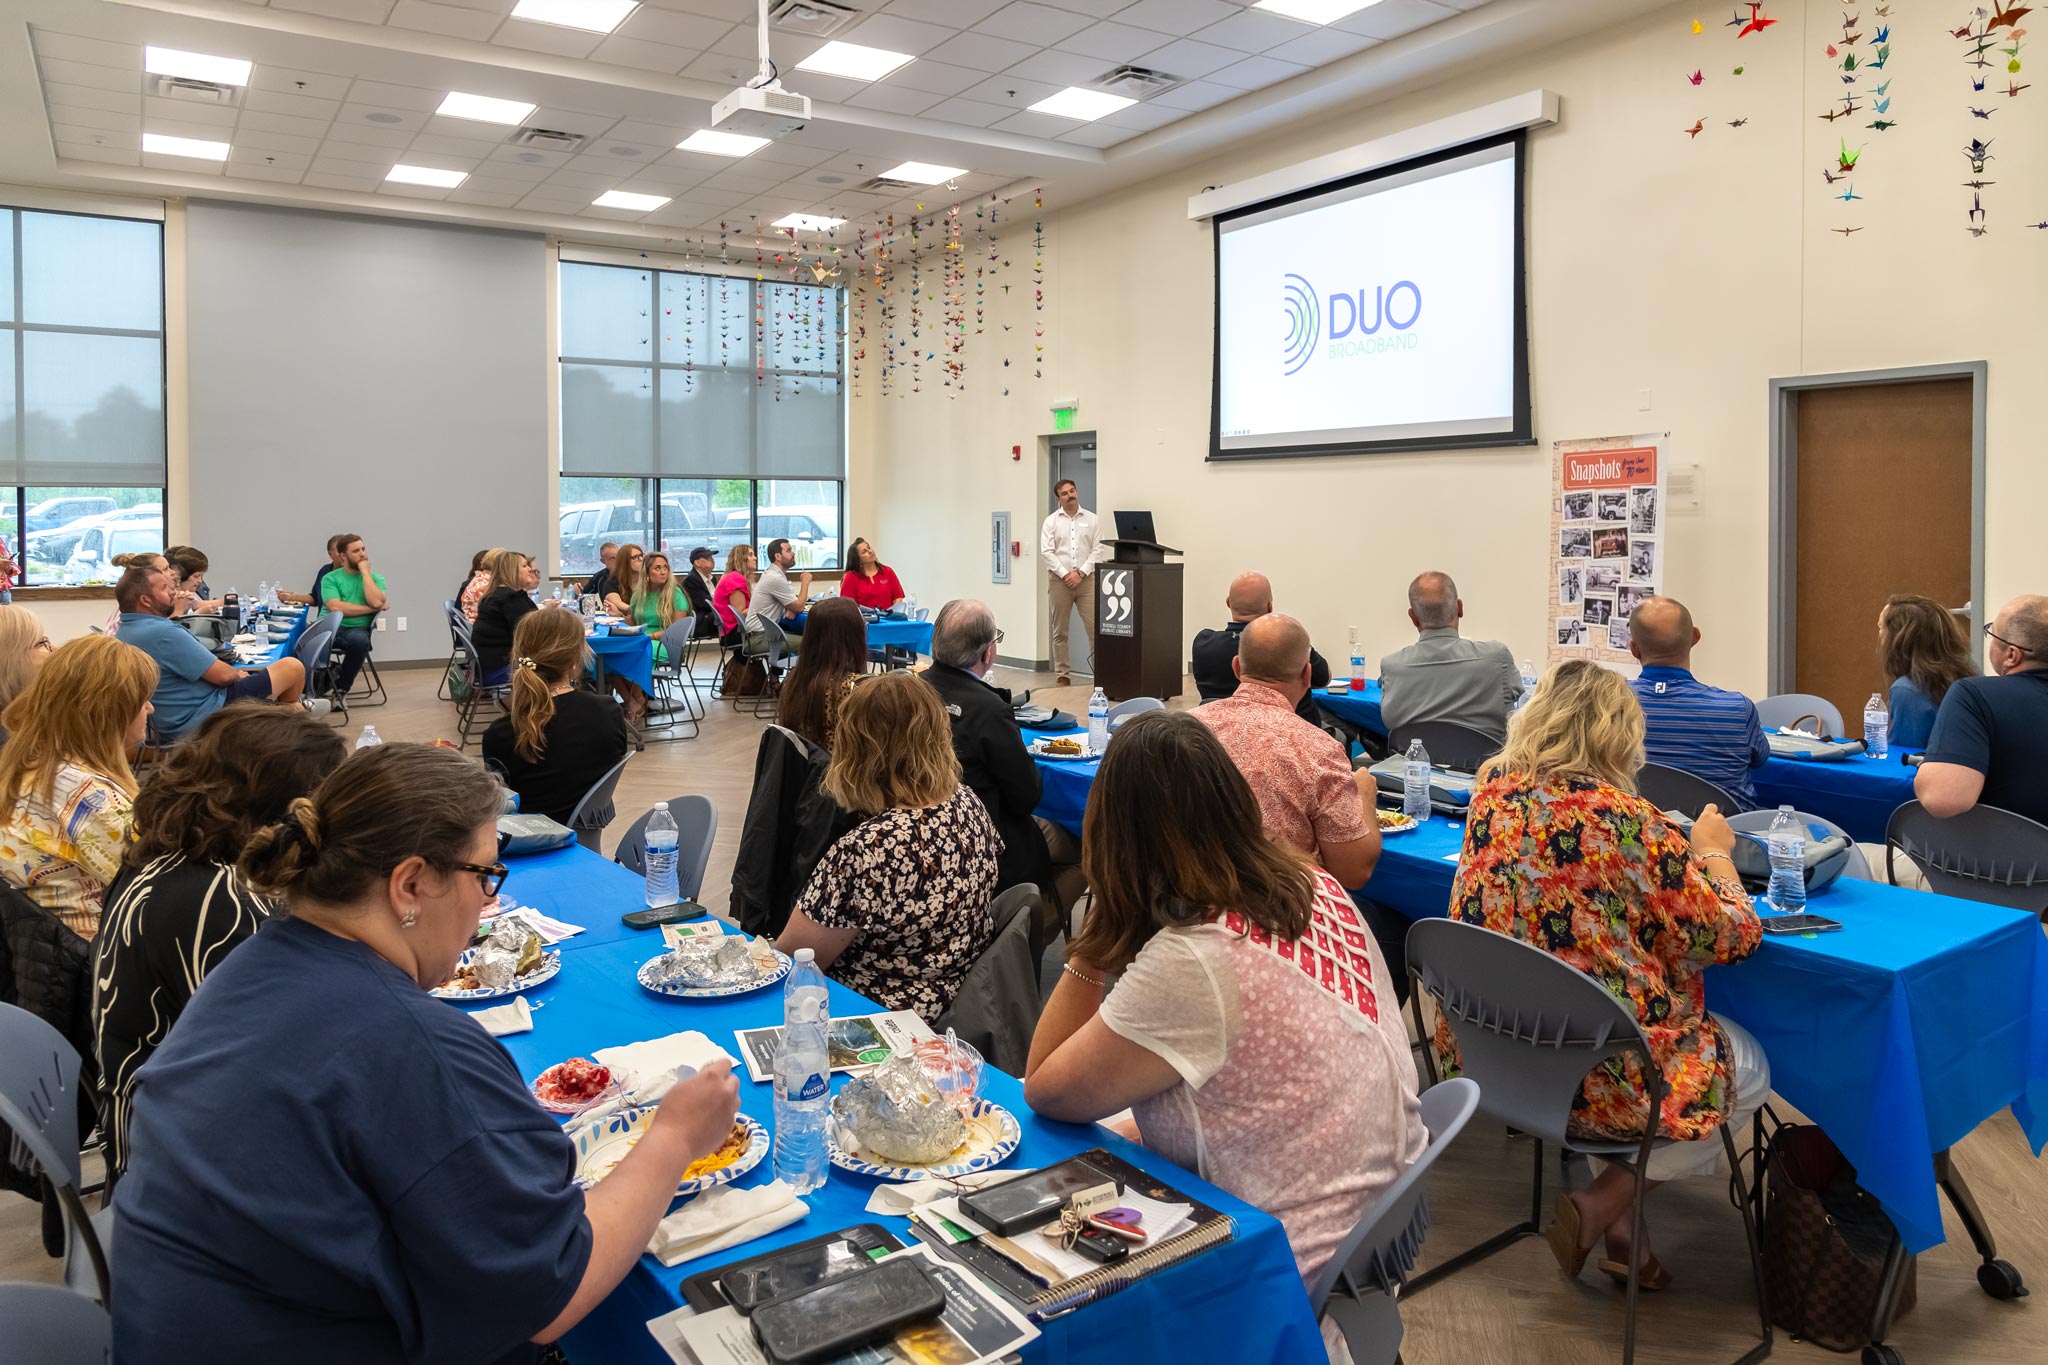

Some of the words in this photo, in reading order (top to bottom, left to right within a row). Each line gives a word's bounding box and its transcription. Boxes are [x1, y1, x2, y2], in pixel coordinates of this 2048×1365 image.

[1329, 280, 1422, 340] DUO
[1329, 333, 1418, 359] BROADBAND
[1570, 458, 1621, 484] Snapshots
[1655, 681, 1666, 694] FJ
[802, 1083, 825, 1097] WATER
[933, 1272, 954, 1292] Shades
